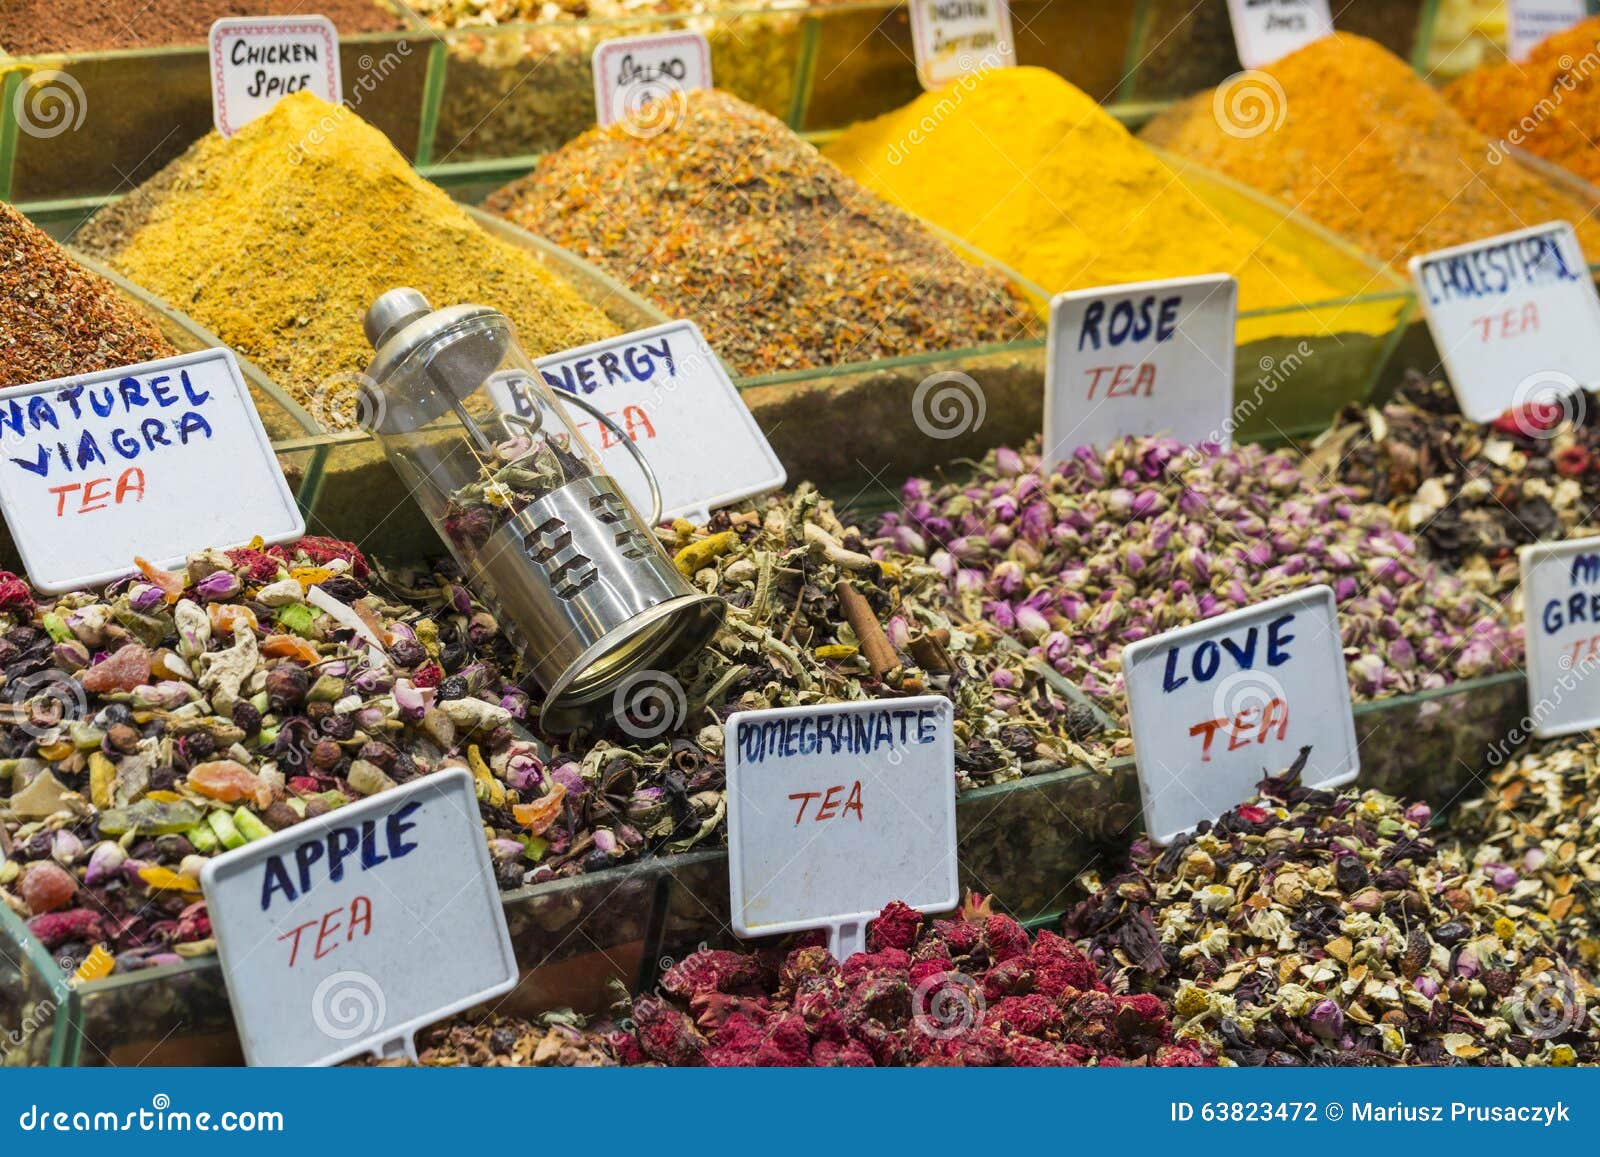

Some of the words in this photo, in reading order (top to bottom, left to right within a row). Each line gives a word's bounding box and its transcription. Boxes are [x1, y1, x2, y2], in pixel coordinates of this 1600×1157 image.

[231, 39, 318, 66] CHICKEN
[247, 70, 311, 98] SPICE
[1078, 295, 1182, 352] ROSE
[1472, 301, 1540, 343] TEA
[0, 369, 212, 440] NATUREL
[507, 338, 676, 417] ENERGY
[1084, 362, 1156, 401] TEA
[9, 411, 212, 477] VIAGRA
[48, 467, 146, 517] TEA
[1163, 603, 1296, 694] LOVE
[737, 709, 937, 765] POMEGRANATE
[1189, 697, 1289, 762] TEA
[788, 780, 864, 825] TEA
[261, 801, 423, 911] APPLE
[277, 896, 372, 968] TEA
